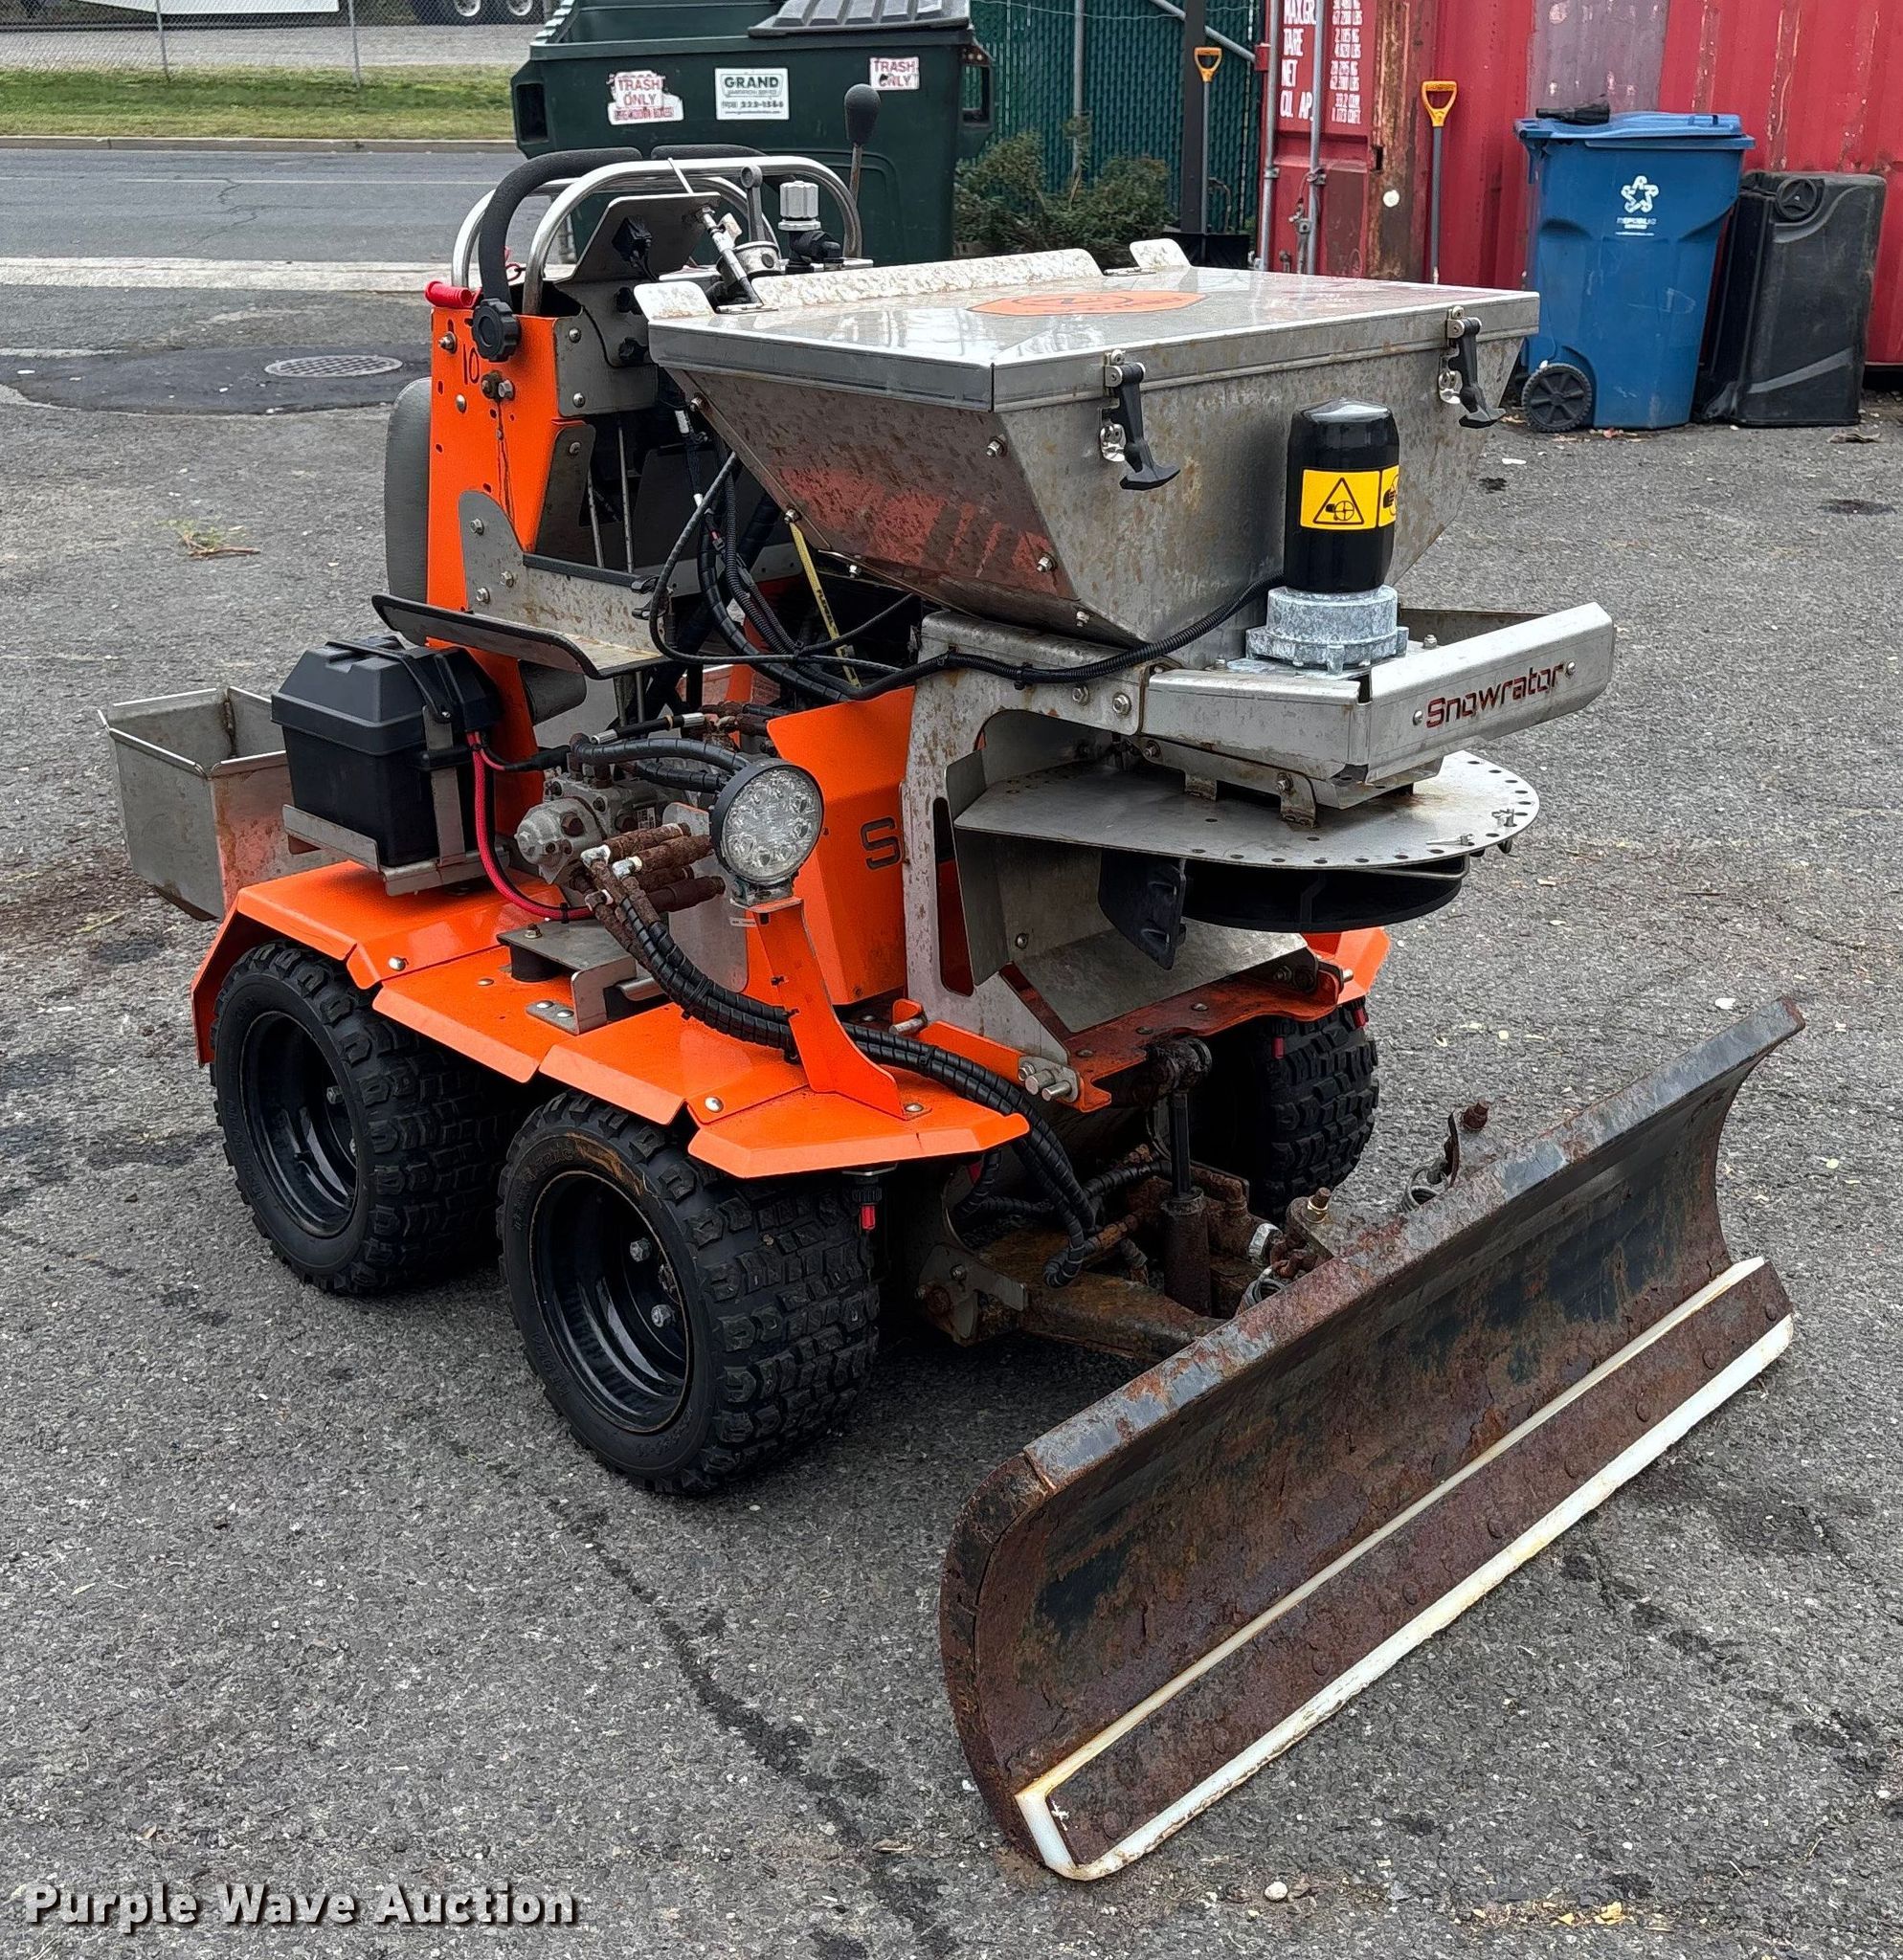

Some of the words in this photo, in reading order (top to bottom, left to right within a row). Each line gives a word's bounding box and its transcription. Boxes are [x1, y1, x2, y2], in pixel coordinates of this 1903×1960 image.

[1284, 28, 1304, 56] TARE
[874, 60, 916, 73] TRASH
[1282, 58, 1298, 87] NET
[617, 78, 661, 92] TRASH
[724, 77, 779, 89] GRAND
[623, 93, 657, 106] ONLY
[1426, 663, 1564, 728] Snowrator
